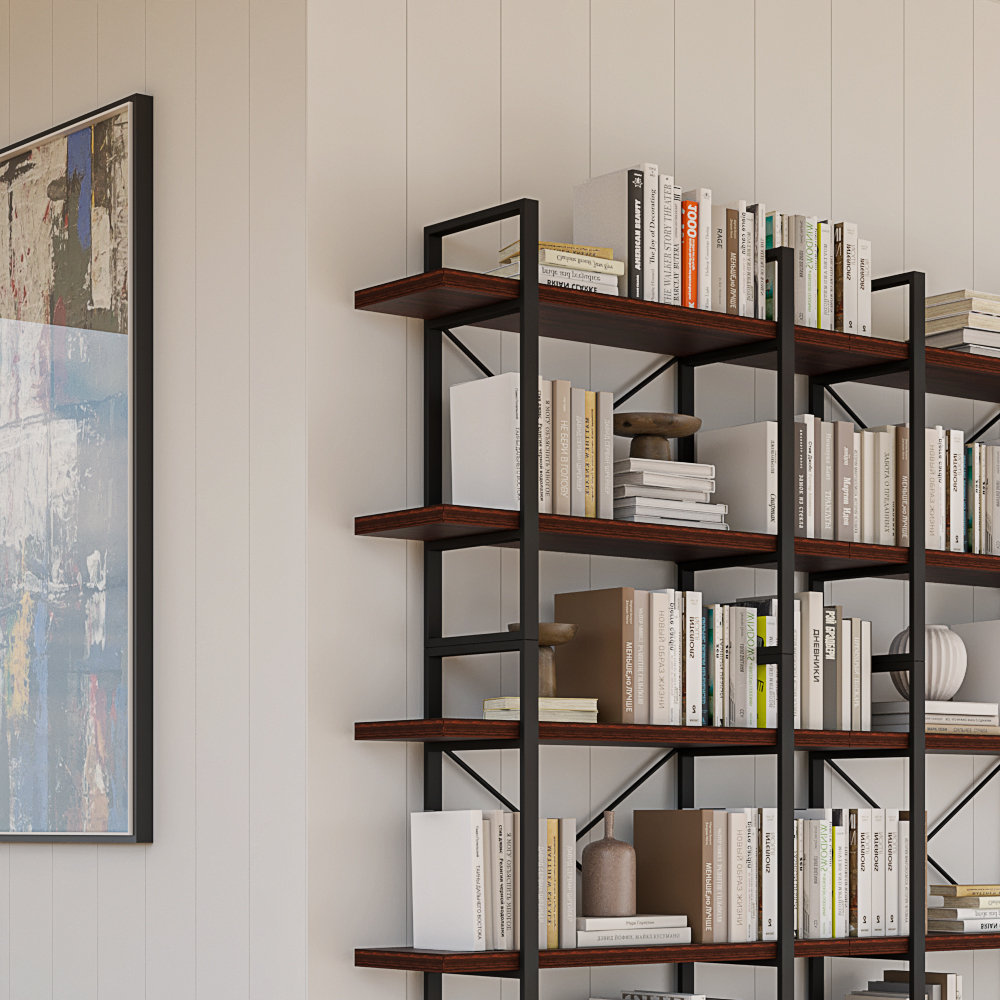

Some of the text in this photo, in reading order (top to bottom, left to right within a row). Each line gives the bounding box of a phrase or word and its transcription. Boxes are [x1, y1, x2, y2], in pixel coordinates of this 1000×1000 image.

[634, 199, 642, 230] BEAUTY
[649, 189, 657, 229] Decorating
[664, 184, 672, 222] THEATER
[649, 230, 657, 238] of
[649, 238, 657, 252] Joy
[664, 223, 672, 252] STORY
[634, 231, 642, 271] AMERICAN
[649, 251, 657, 265] The
[664, 252, 672, 286] WALKER
[842, 477, 851, 505] Мартин
[825, 610, 837, 625] РЭЙ
[658, 646, 666, 675] ОБРАЗ
[625, 686, 633, 713] ЛУЧШЕ
[658, 676, 666, 710] ЖИЗНИ
